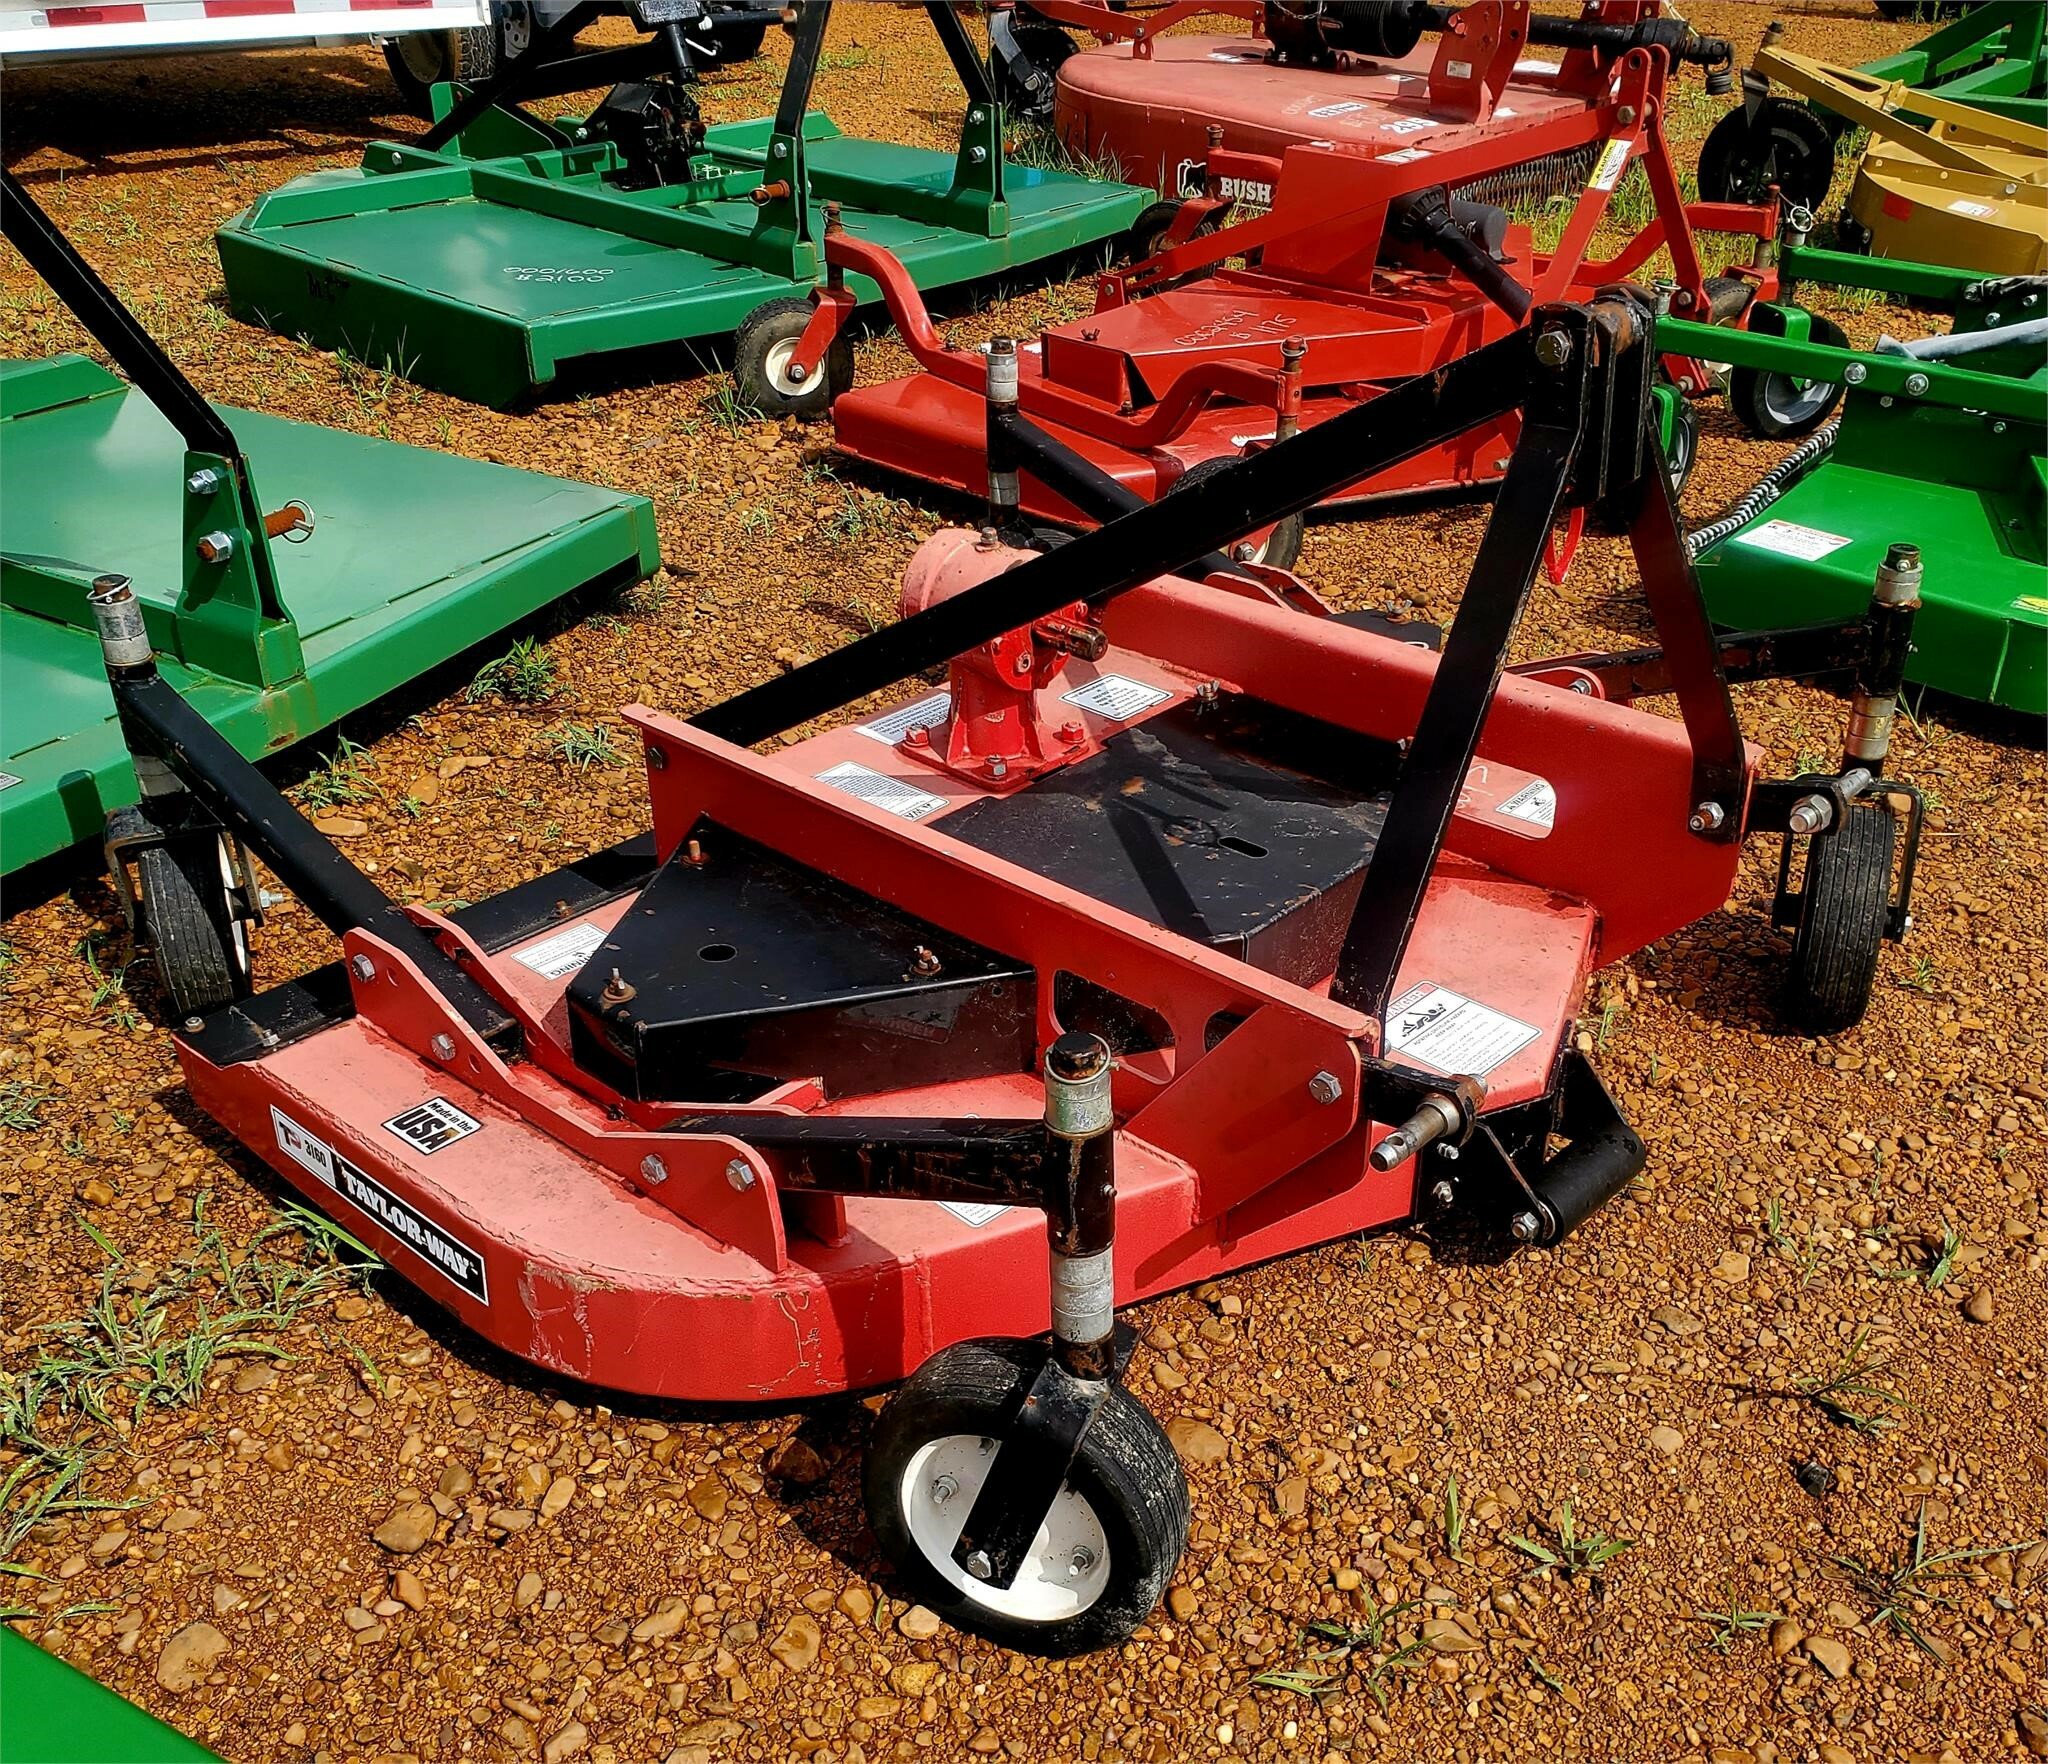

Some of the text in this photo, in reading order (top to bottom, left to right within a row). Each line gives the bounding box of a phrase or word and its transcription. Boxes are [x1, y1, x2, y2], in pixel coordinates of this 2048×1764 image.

[1220, 176, 1272, 203] BUSH
[392, 1108, 461, 1150] USA
[427, 1102, 473, 1132] Made in the
[304, 1139, 327, 1168] 3160
[341, 1166, 470, 1280] TAYLOR-WAY
